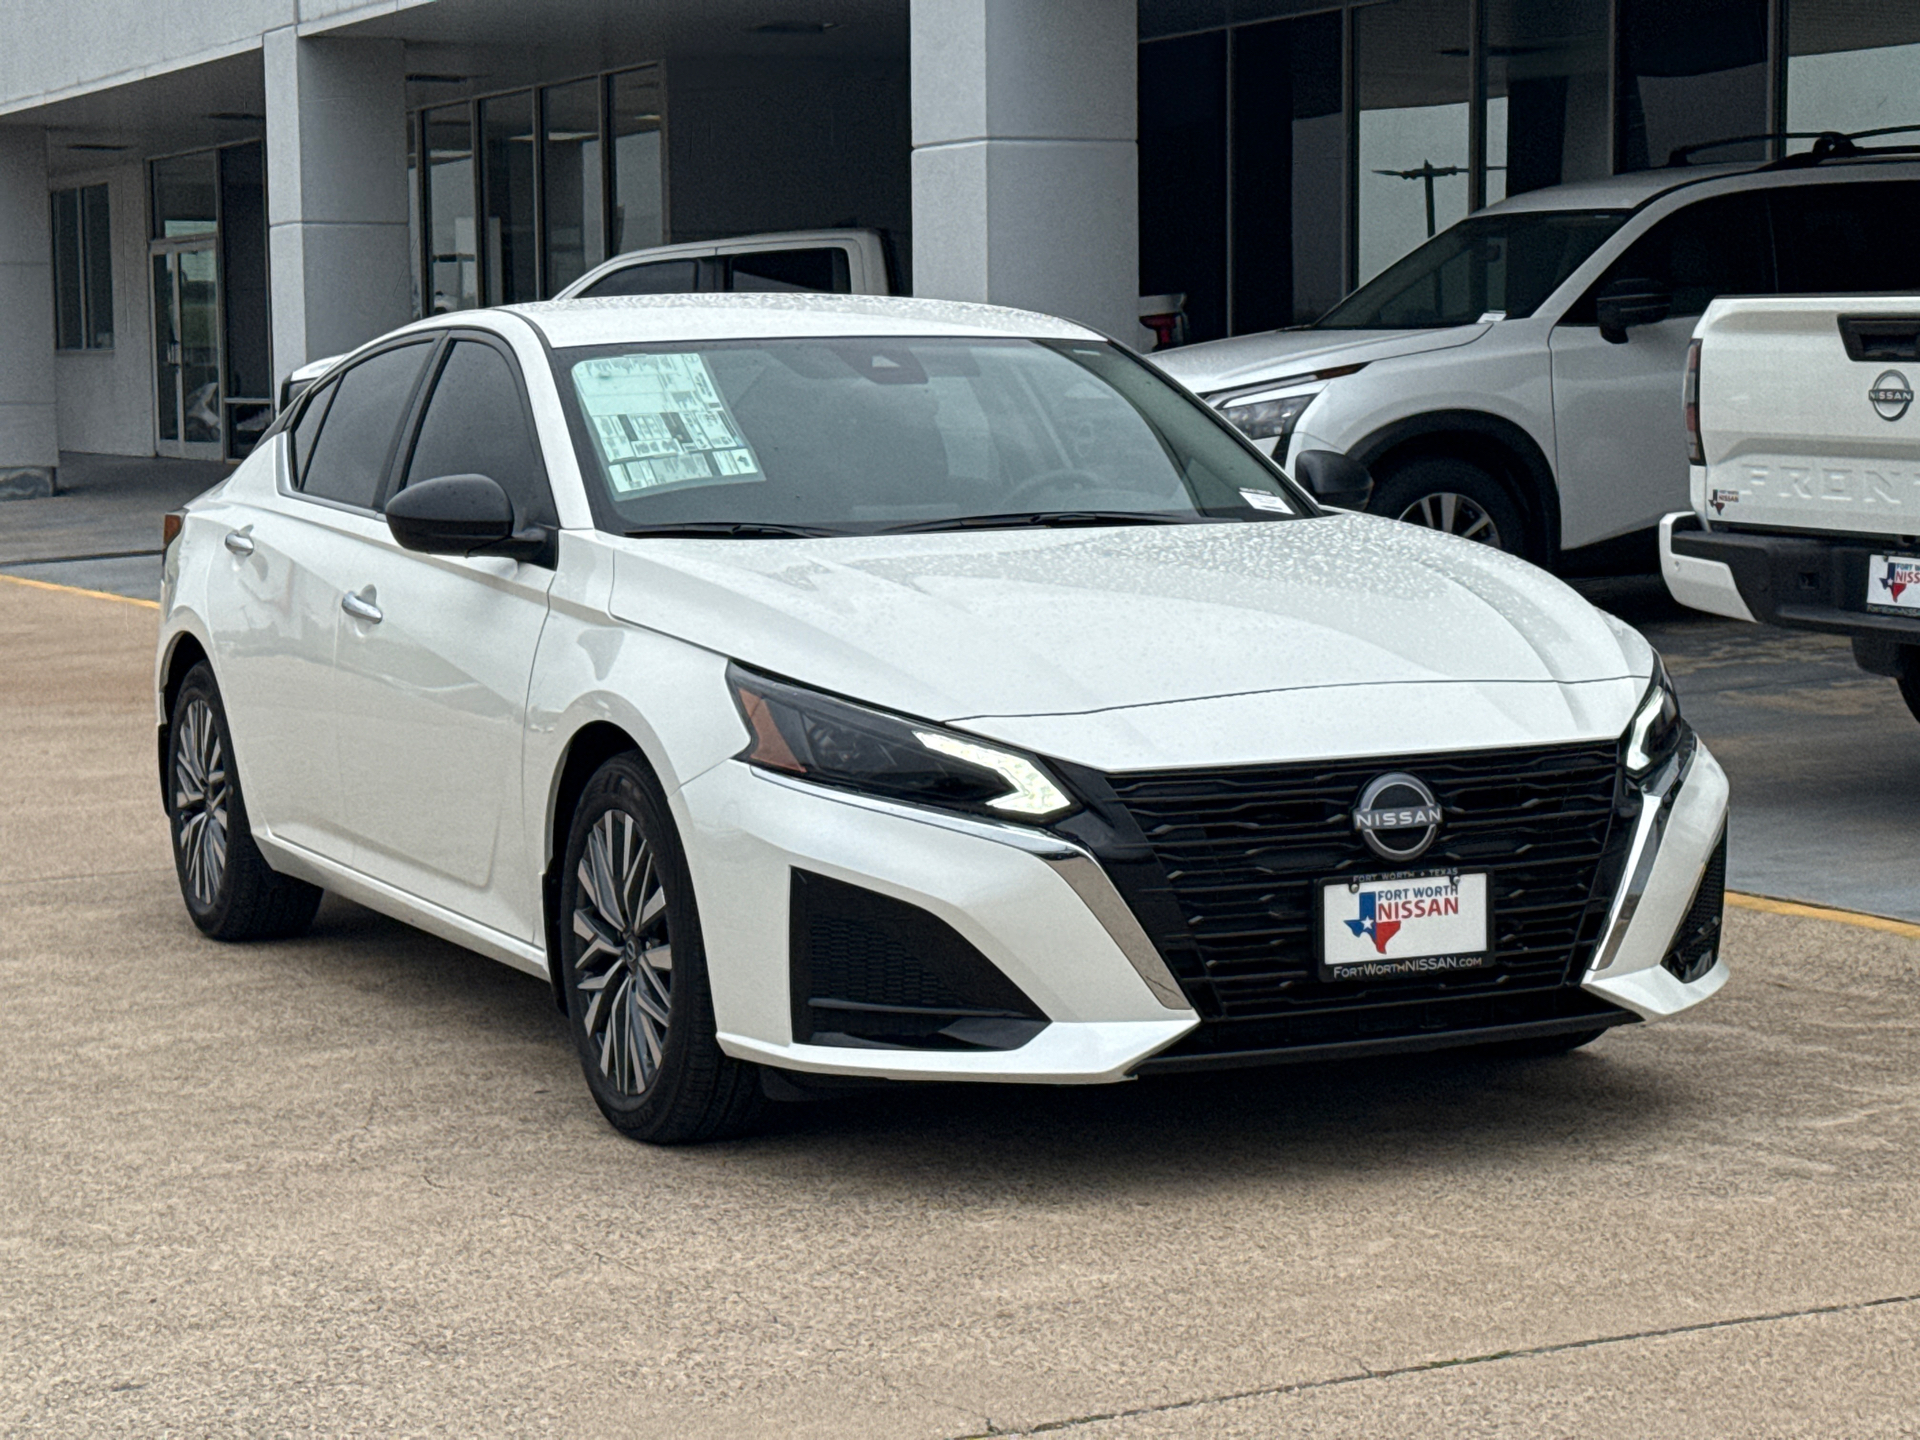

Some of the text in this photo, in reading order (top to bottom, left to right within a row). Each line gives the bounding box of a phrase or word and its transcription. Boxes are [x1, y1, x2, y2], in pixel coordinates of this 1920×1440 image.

[1869, 391, 1911, 400] NISSAN
[1740, 464, 1920, 504] FRON
[1355, 808, 1441, 828] NISSAN
[1352, 867, 1458, 883] FORT WORTH TEXAS
[1377, 885, 1459, 901] FORT WORTH
[1377, 897, 1459, 921] NISSAN
